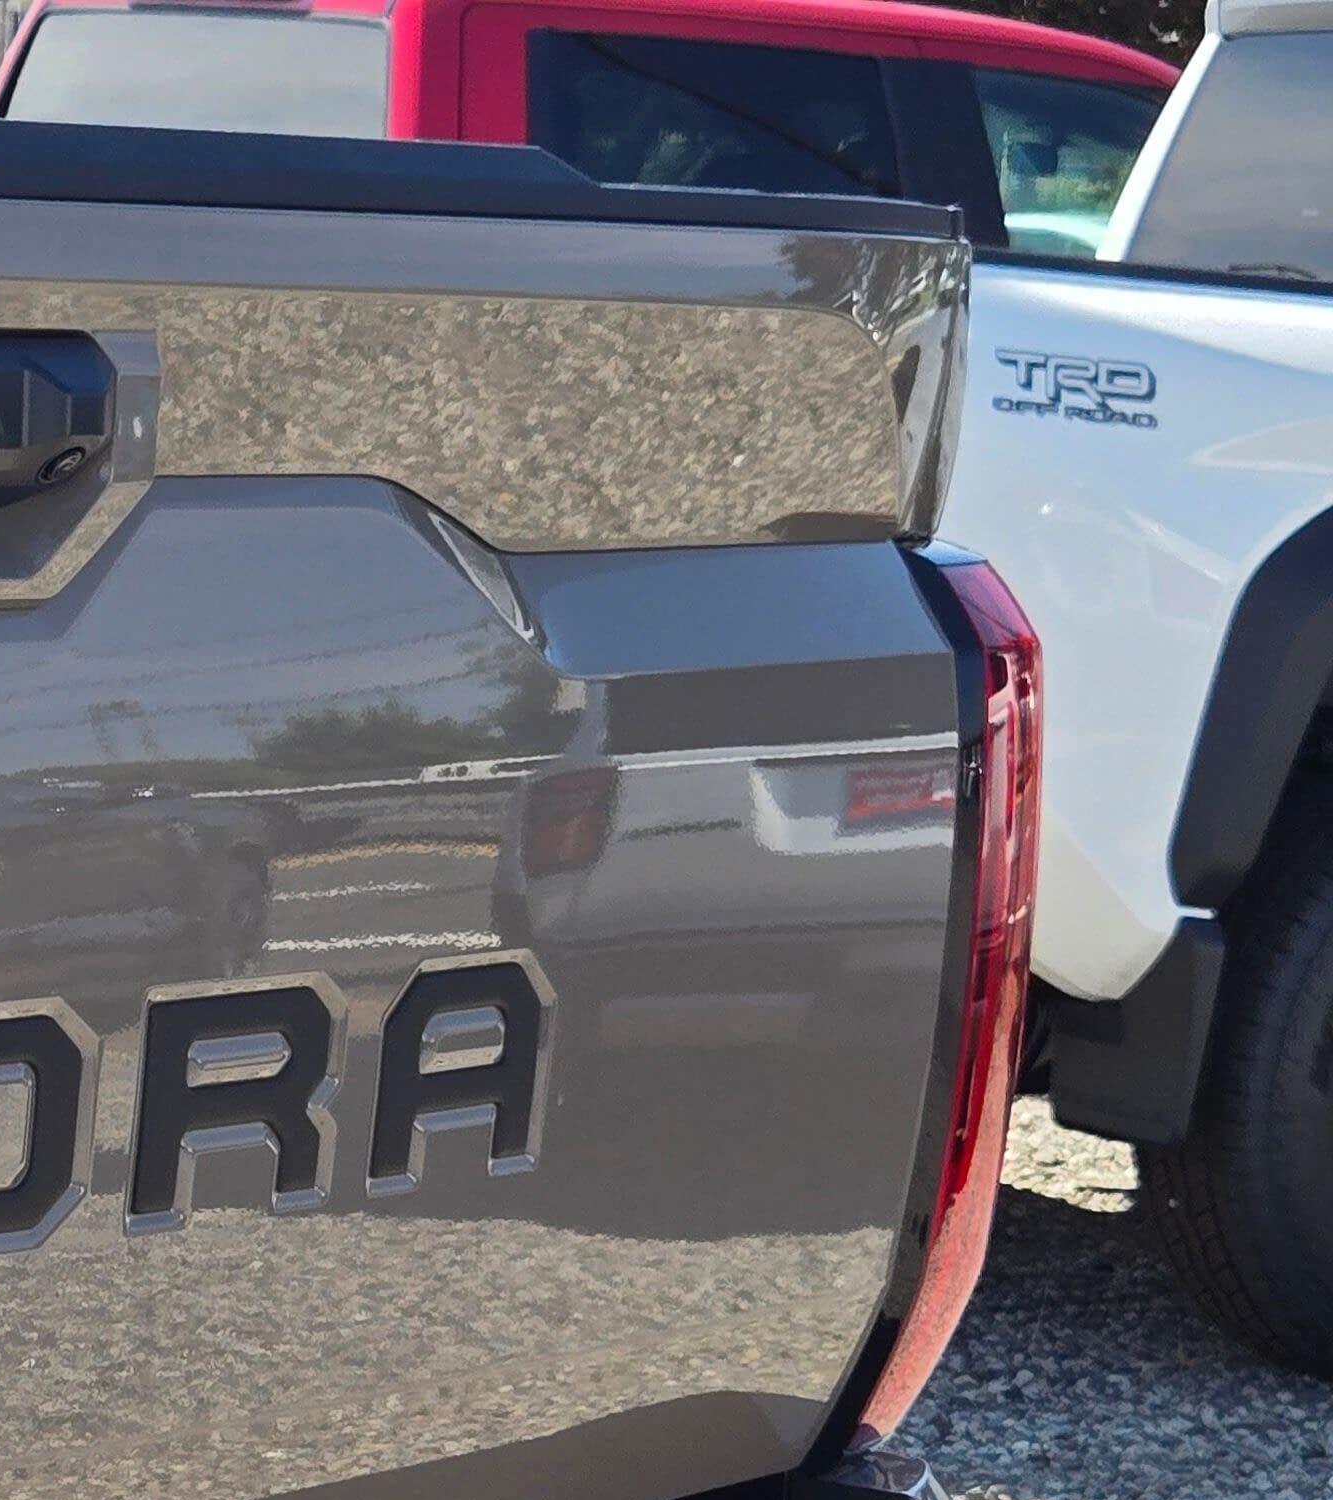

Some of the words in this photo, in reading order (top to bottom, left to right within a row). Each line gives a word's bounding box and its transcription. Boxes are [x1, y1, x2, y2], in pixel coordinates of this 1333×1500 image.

[994, 348, 1157, 404] TRD
[992, 396, 1057, 416] OFF
[1064, 405, 1158, 428] ROAD
